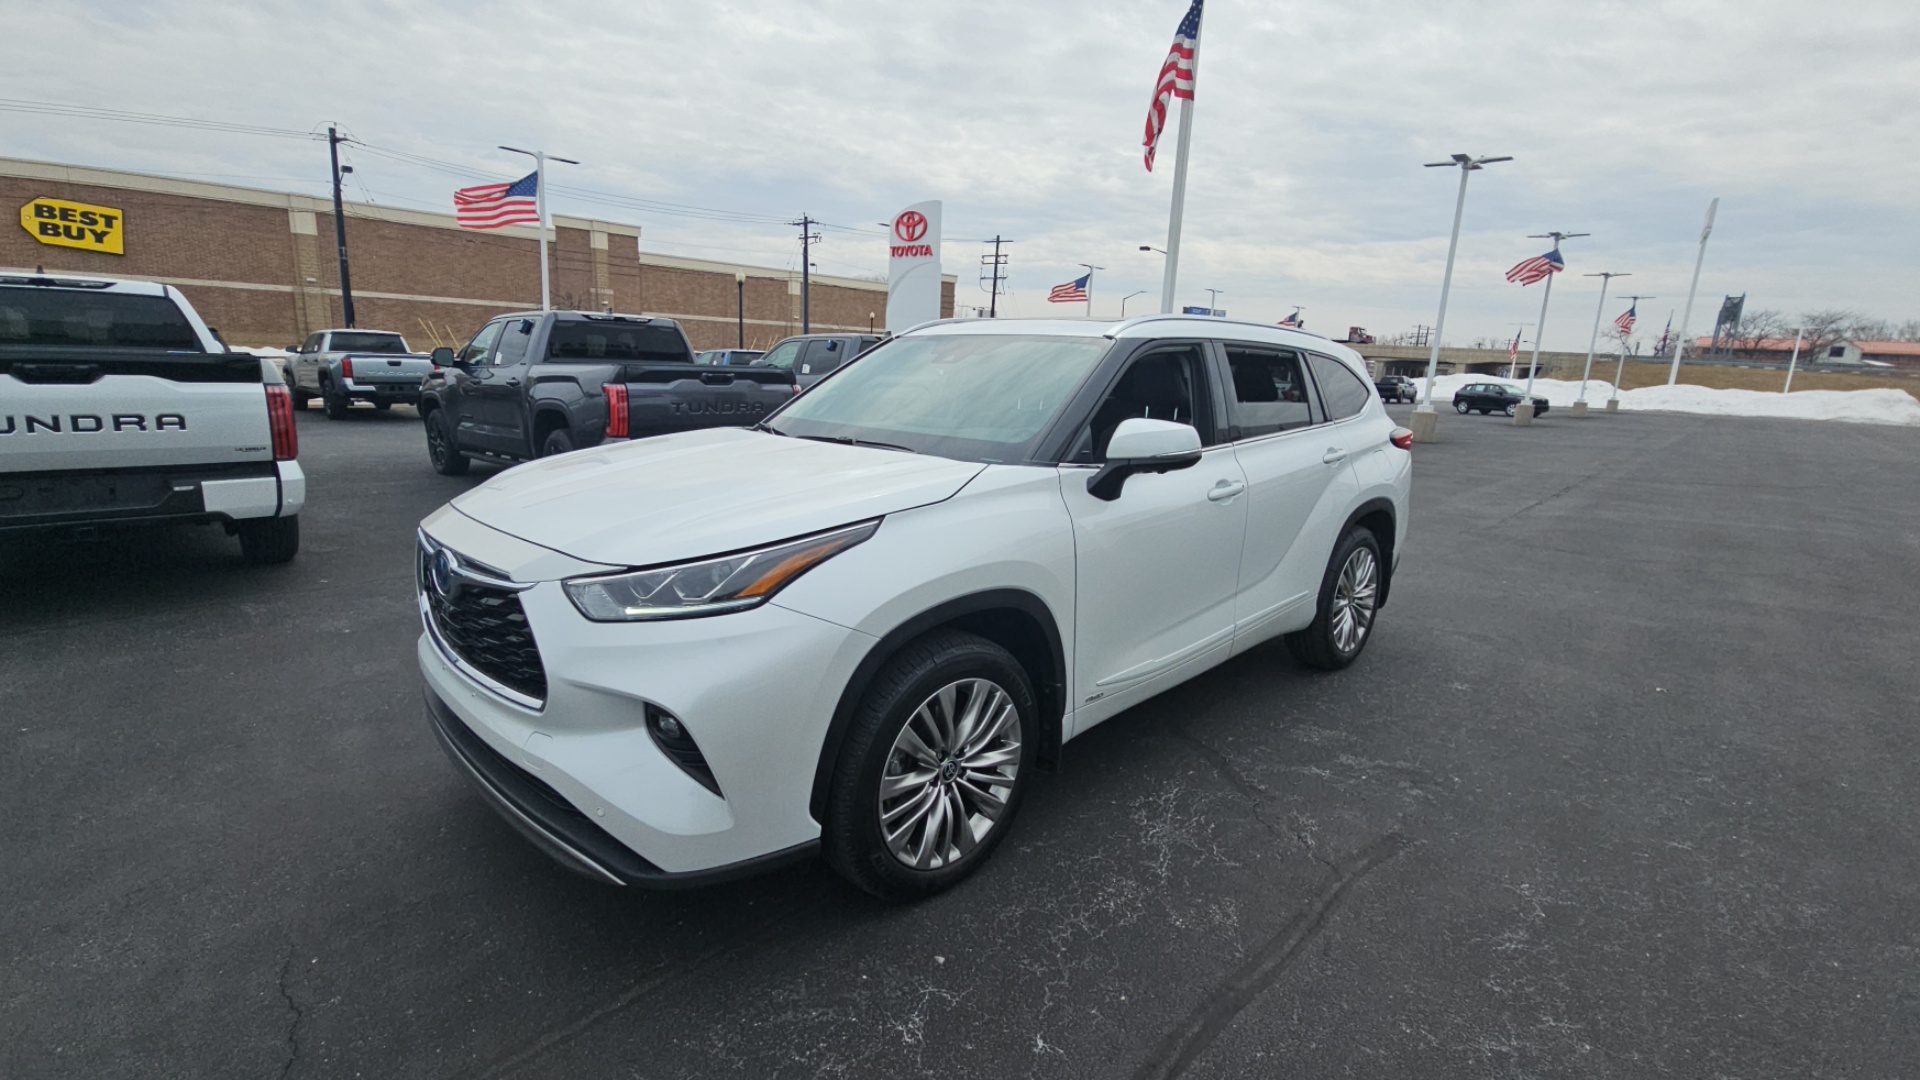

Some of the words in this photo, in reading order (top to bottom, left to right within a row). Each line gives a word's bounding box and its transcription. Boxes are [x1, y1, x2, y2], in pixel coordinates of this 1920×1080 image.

[33, 203, 118, 229] BEST
[39, 221, 112, 244] BUY
[890, 245, 933, 257] TOYOTA
[671, 401, 764, 415] TUNDRA
